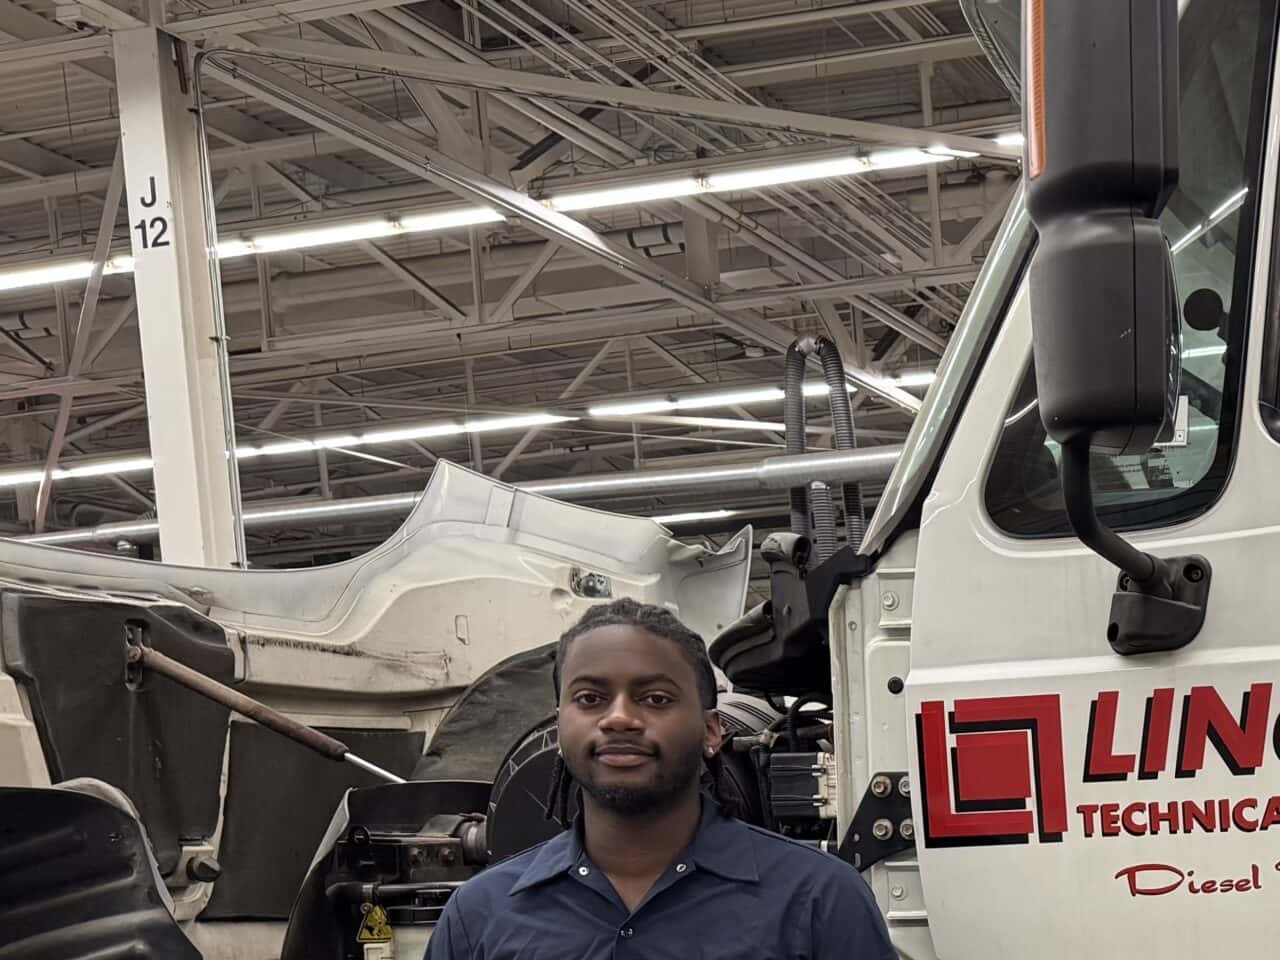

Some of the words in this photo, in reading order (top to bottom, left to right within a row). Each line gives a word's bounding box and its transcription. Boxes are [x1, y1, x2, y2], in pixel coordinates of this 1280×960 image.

[140, 176, 157, 208] J
[134, 216, 170, 249] 12
[1114, 863, 1263, 898] Diesel
